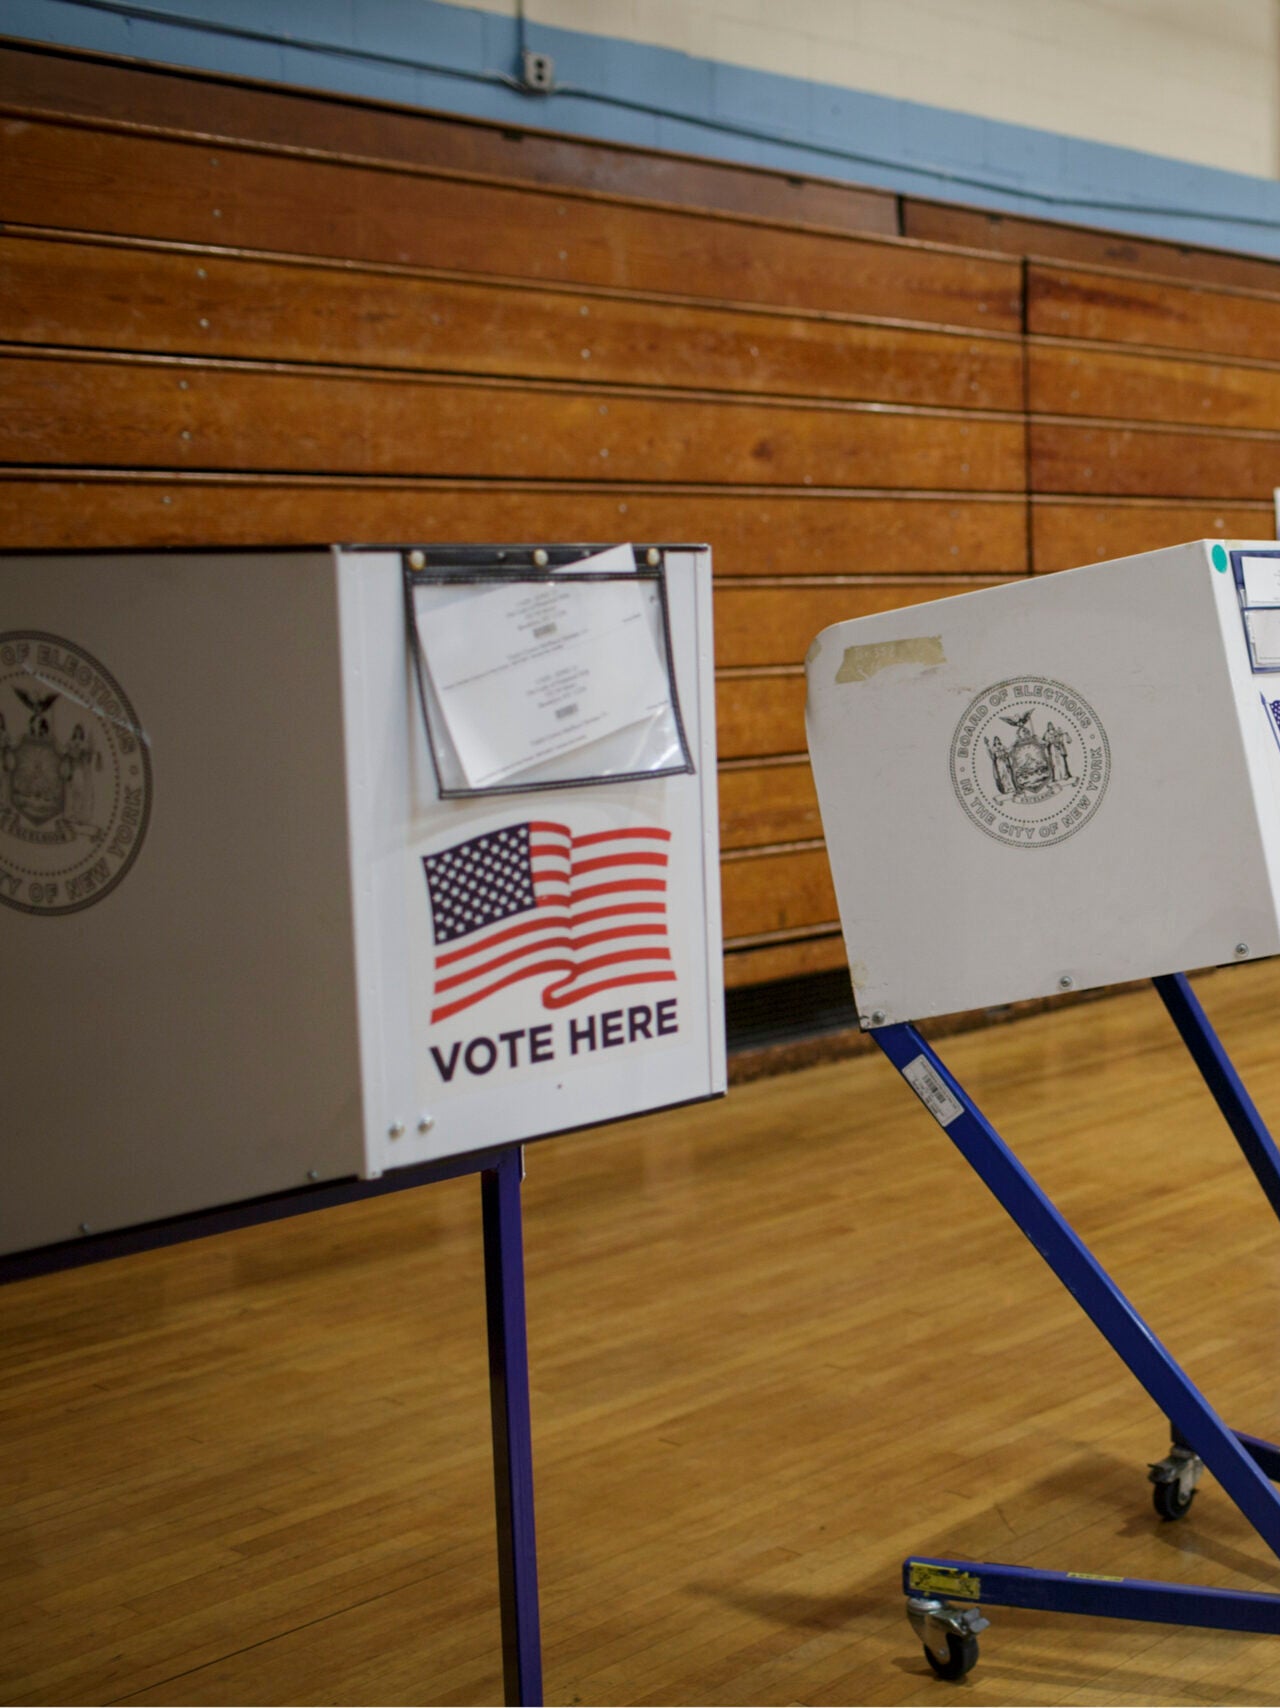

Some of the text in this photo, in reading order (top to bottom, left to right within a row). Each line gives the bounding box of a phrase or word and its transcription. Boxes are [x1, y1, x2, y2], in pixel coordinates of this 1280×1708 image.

[1, 643, 30, 666] OF
[957, 685, 1091, 758] BOARD OF ELECTIONS
[960, 746, 1103, 839] IN THE CITY OF NEW YORK
[28, 882, 59, 904] OF
[65, 857, 112, 901] NEW
[107, 785, 142, 859] YORK
[429, 997, 680, 1083] VOTE HERE
